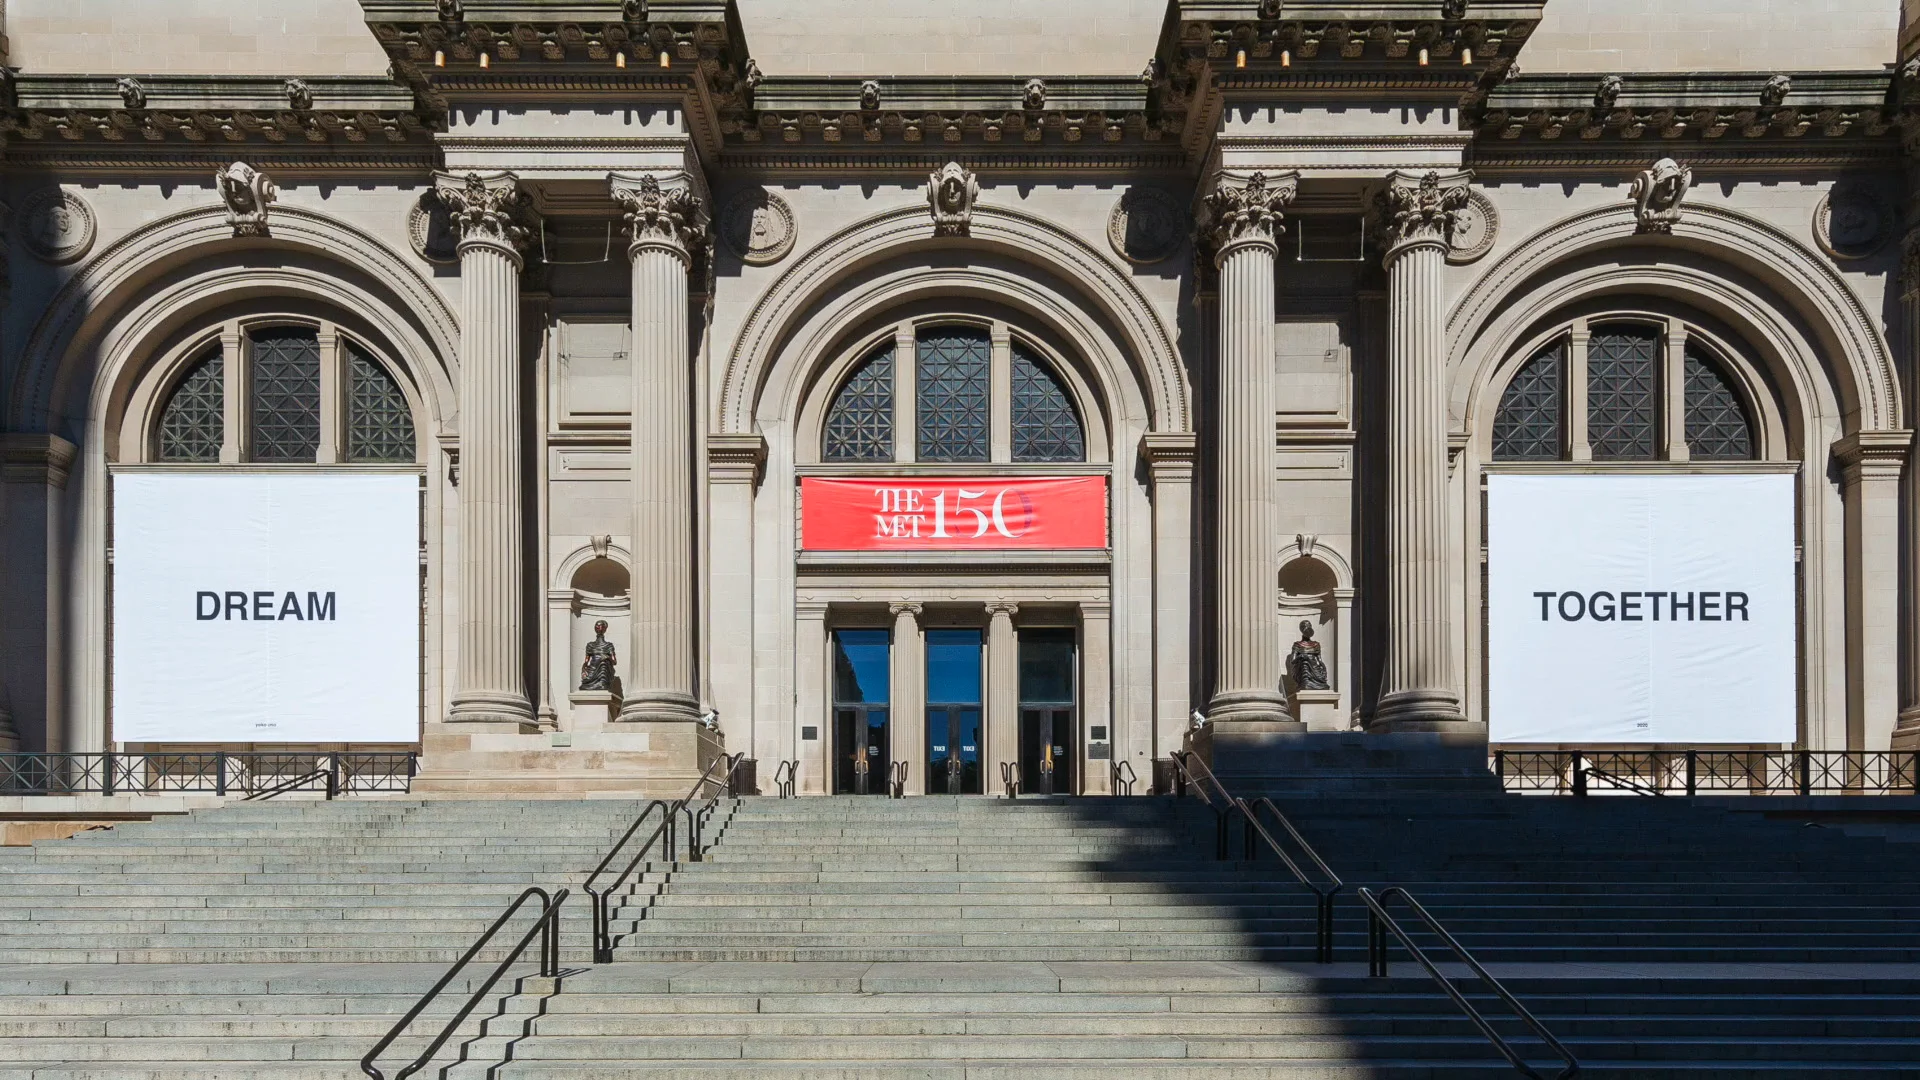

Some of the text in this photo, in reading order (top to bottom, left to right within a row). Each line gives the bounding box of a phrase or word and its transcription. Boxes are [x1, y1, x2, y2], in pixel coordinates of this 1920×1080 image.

[874, 488, 925, 513] THE
[928, 487, 1033, 539] 150
[875, 514, 926, 538] MET
[195, 591, 337, 622] DREAM
[1533, 591, 1750, 622] TOGETHER
